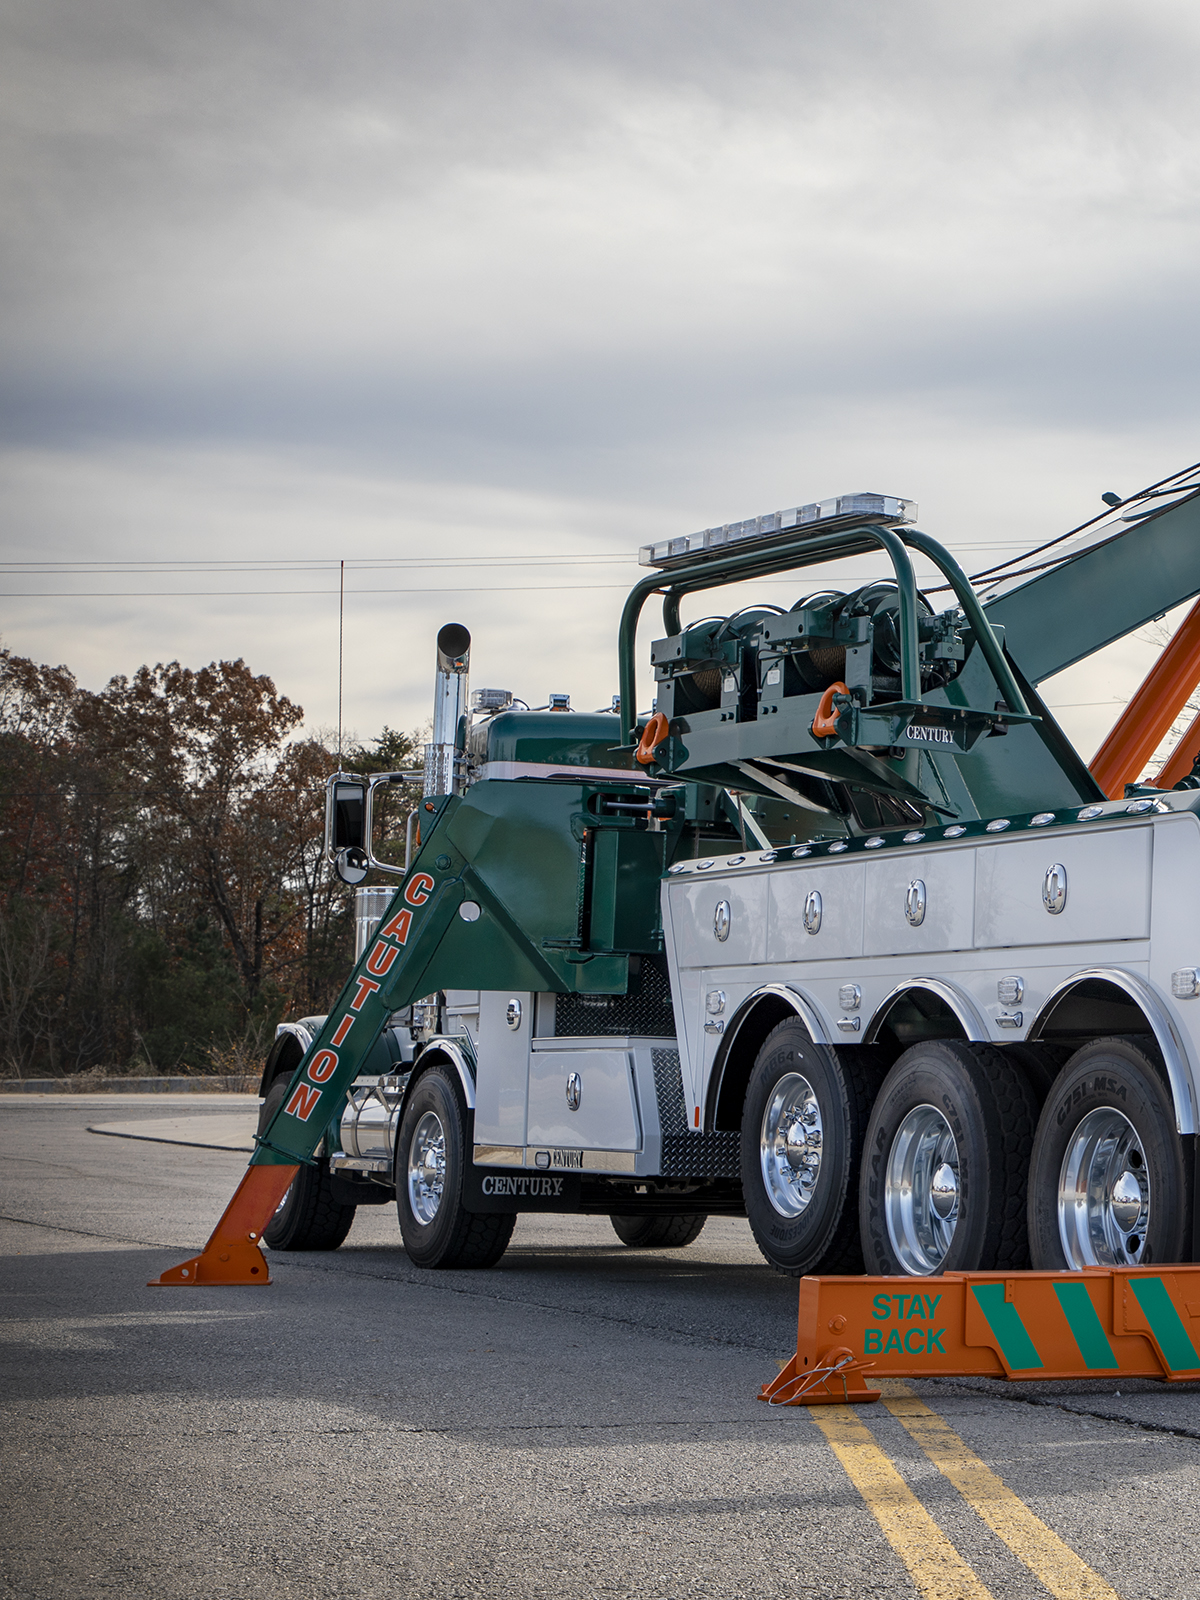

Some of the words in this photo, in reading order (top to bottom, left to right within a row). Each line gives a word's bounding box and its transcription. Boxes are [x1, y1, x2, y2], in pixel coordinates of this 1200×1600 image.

[906, 725, 955, 744] CENTURY
[284, 872, 435, 1122] CAUTION
[1094, 1077, 1127, 1102] MSA
[482, 1176, 563, 1196] CENTURY
[871, 1293, 943, 1320] STAY
[864, 1327, 947, 1354] BACK
